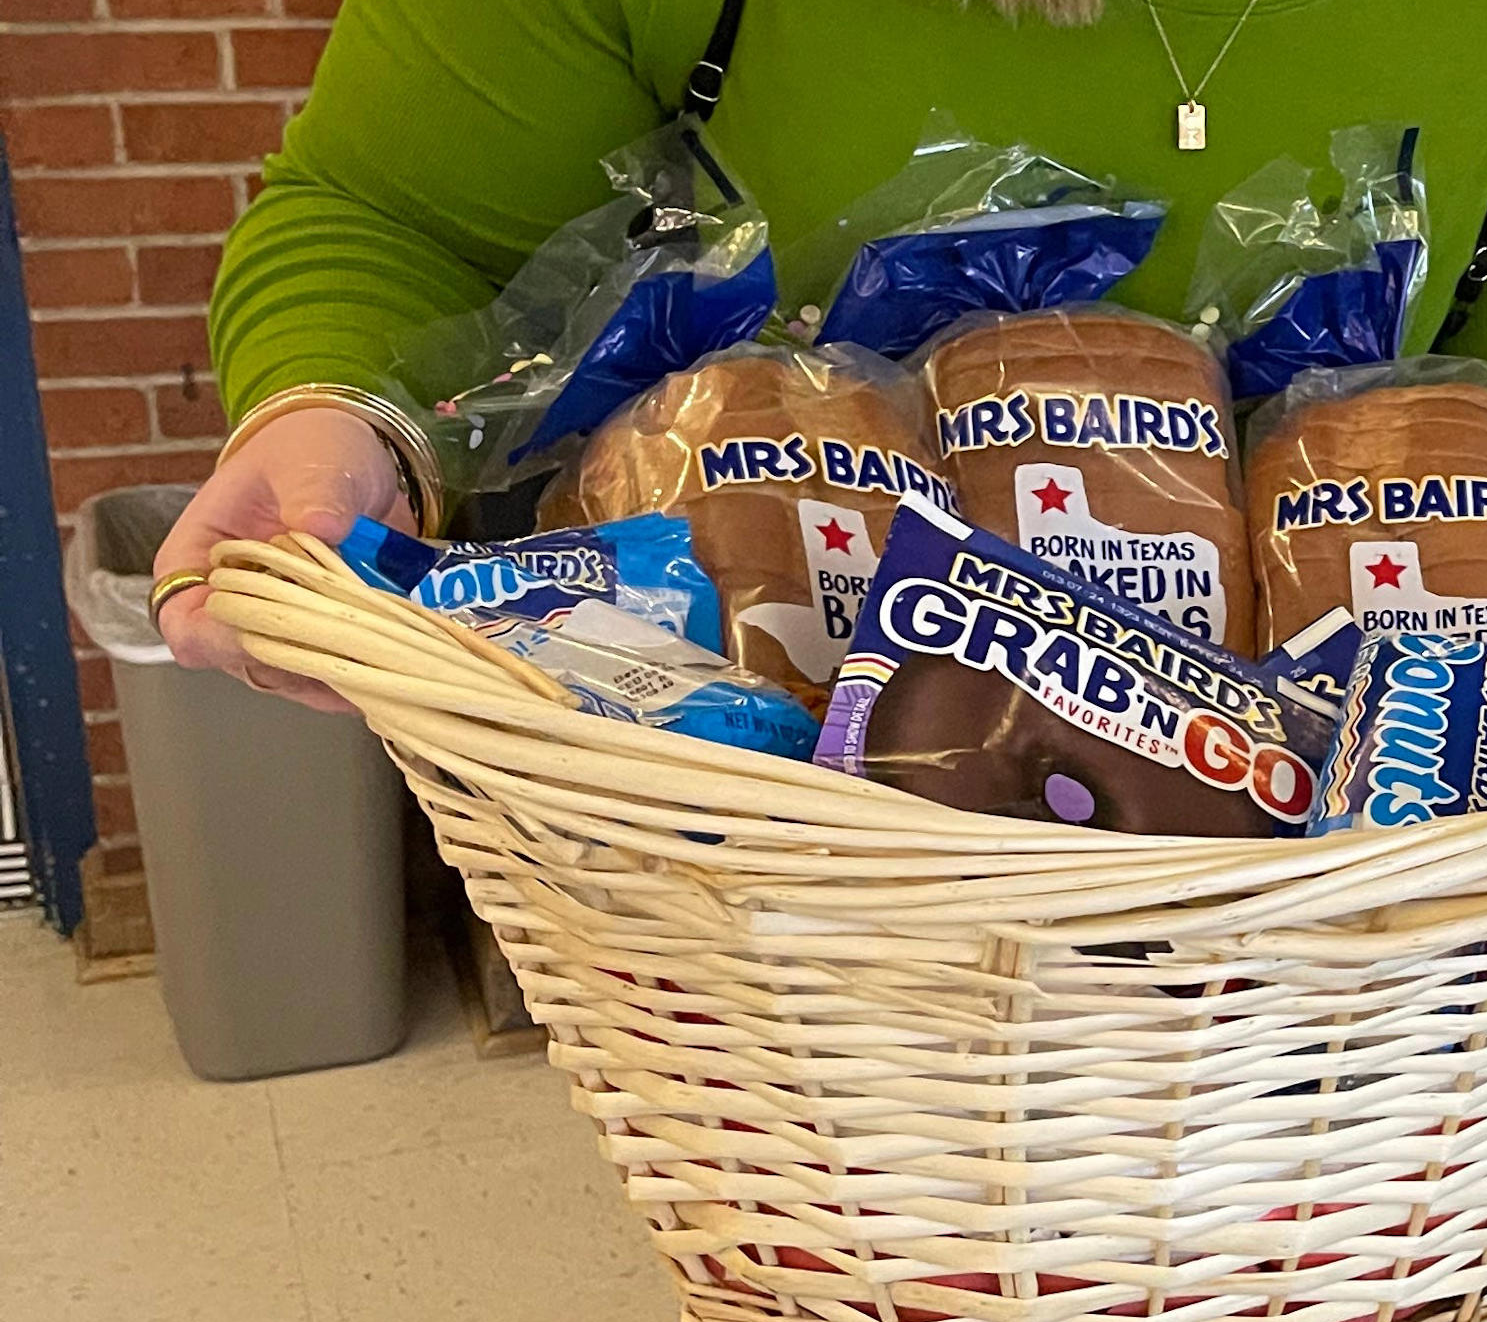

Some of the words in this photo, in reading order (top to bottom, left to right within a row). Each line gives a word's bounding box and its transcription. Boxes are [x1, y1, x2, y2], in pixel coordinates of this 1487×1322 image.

[938, 391, 1033, 458] MRS
[1042, 394, 1225, 457] BAIRD'S
[698, 434, 814, 490] MRS
[1277, 478, 1369, 532] MRS
[1030, 537, 1095, 560] BORN
[1102, 538, 1122, 560] IN
[1127, 539, 1195, 561] TEXAS
[818, 570, 873, 596] BOR
[1176, 568, 1211, 600] IN
[952, 554, 1073, 623] MRS
[1079, 609, 1285, 736] BAIRD'S
[1363, 610, 1427, 631] BORN
[1436, 607, 1456, 628] IN
[1184, 710, 1316, 822] GO
